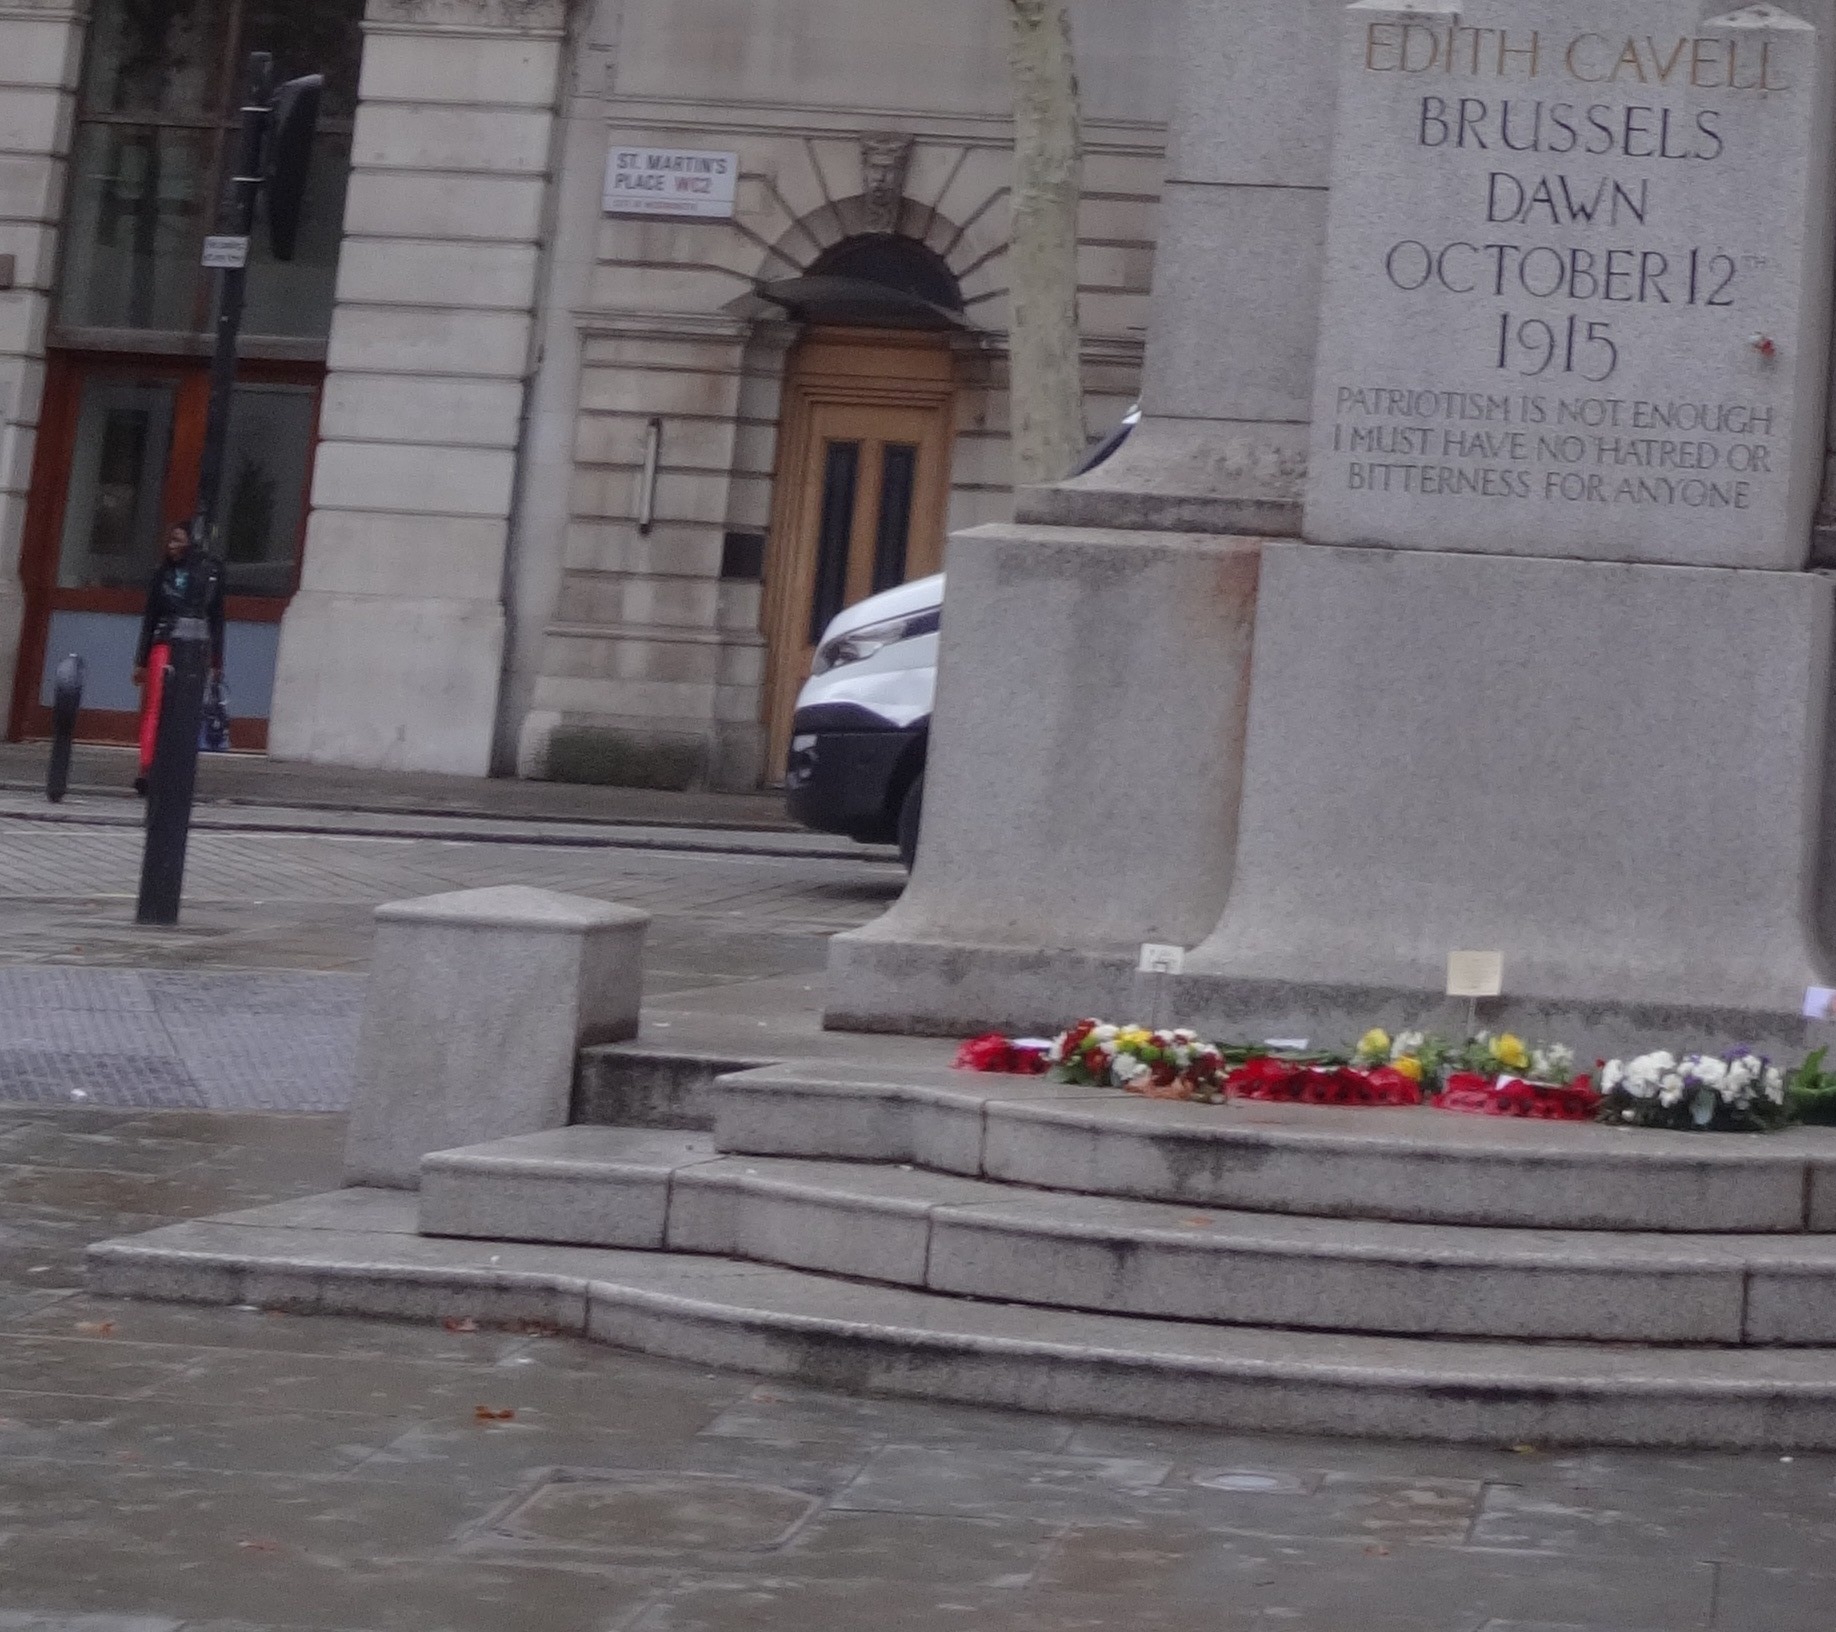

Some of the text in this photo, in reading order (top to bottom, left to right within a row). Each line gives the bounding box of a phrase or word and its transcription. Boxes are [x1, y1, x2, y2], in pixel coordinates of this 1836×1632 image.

[1366, 21, 1792, 92] EDITH CAVELL
[1417, 95, 1724, 161] BRUSSELS
[613, 173, 665, 191] PLACE
[1486, 172, 1649, 225] DAWN
[1386, 240, 1671, 305] OCTOBER
[1498, 312, 1618, 383] 1915
[1336, 387, 1774, 436] PATRIOTISM IS NOT ENOUGH
[1332, 424, 1772, 473] I MUST HAVE NO HATRED OR
[1349, 462, 1751, 510] BITTERNESS FOR ANYONE
